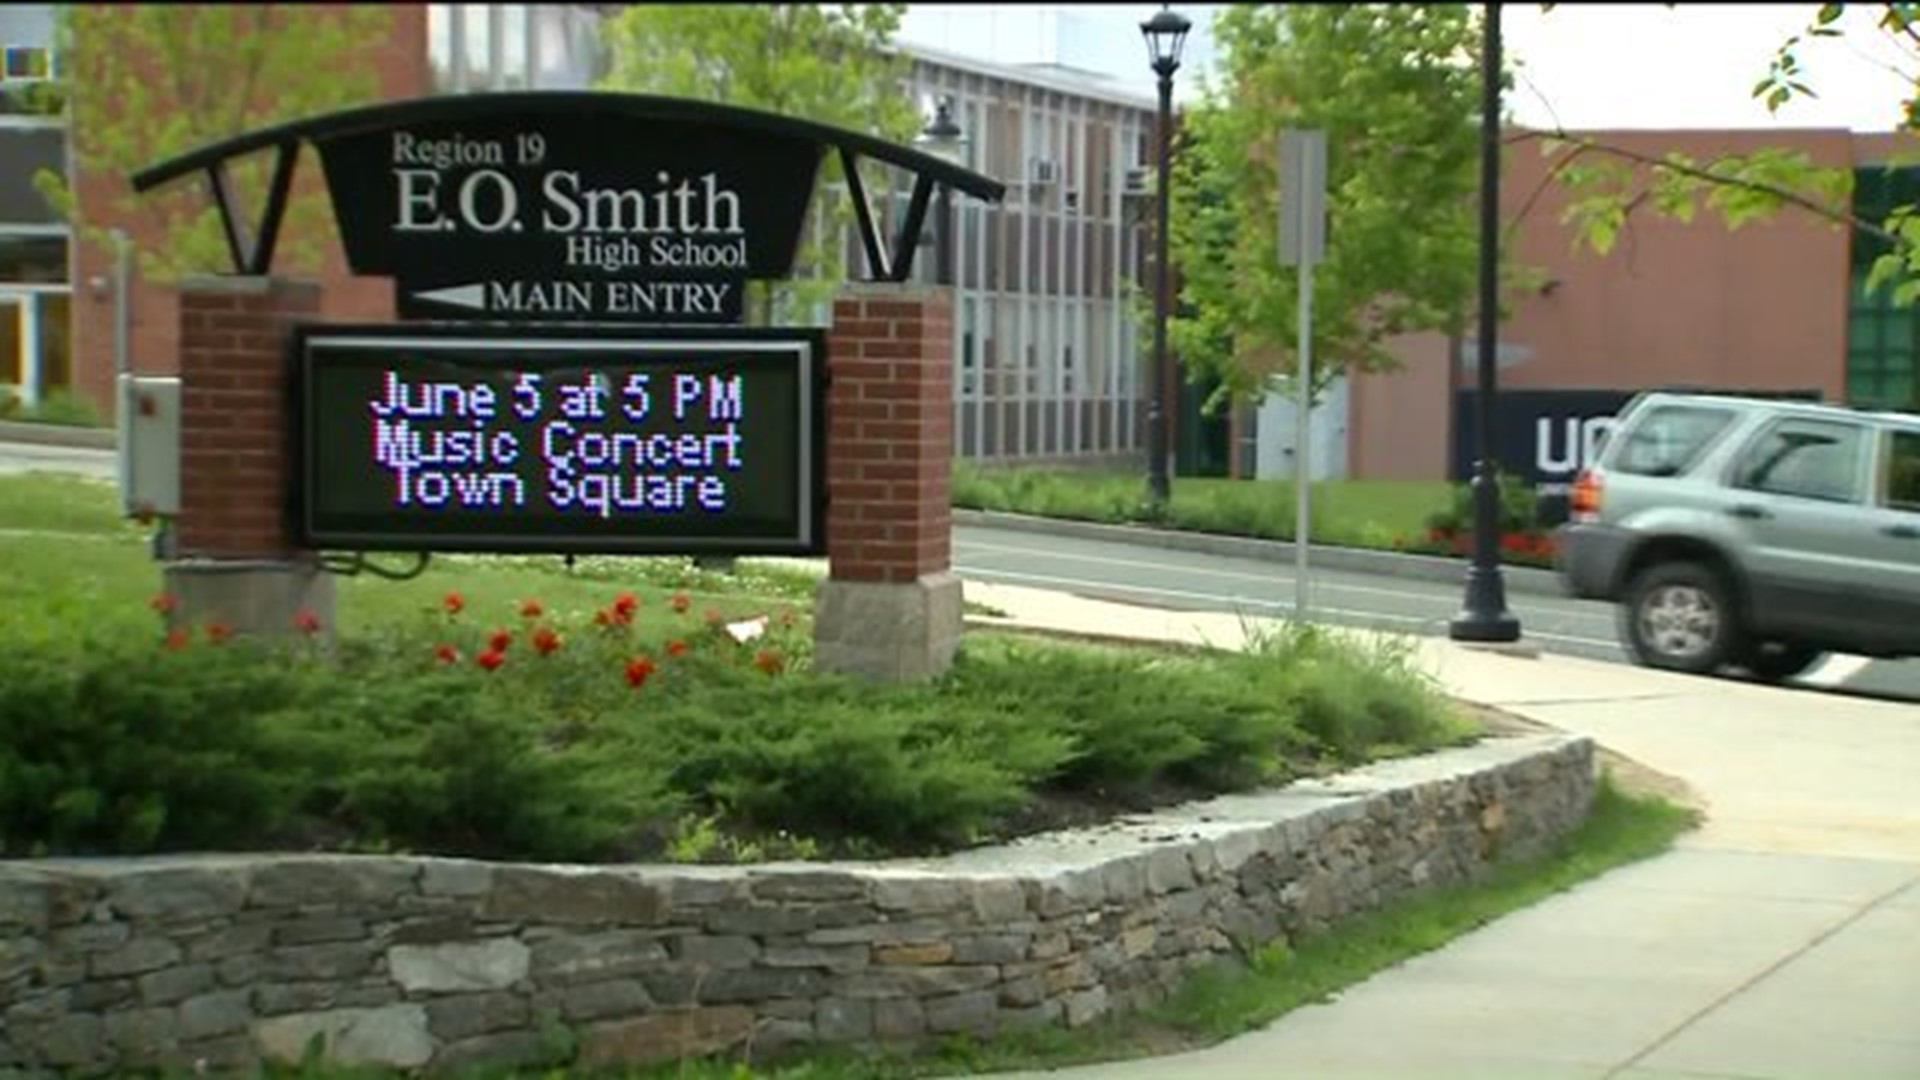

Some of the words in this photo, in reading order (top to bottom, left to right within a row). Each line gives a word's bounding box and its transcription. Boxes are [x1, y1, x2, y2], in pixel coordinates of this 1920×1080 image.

[392, 131, 503, 169] Region
[516, 132, 546, 164] 19
[391, 168, 523, 233] E.O.
[542, 169, 745, 234] Smith
[566, 236, 640, 271] High
[650, 236, 747, 267] School
[491, 280, 593, 312] MAIN
[607, 282, 730, 313] ENTRY
[369, 371, 496, 416] June
[514, 373, 541, 417] 5
[560, 374, 606, 417] at
[622, 374, 650, 418] 5
[376, 418, 519, 464] Music
[544, 421, 742, 466] Concert
[388, 461, 524, 505] Town
[549, 460, 725, 517] Square
